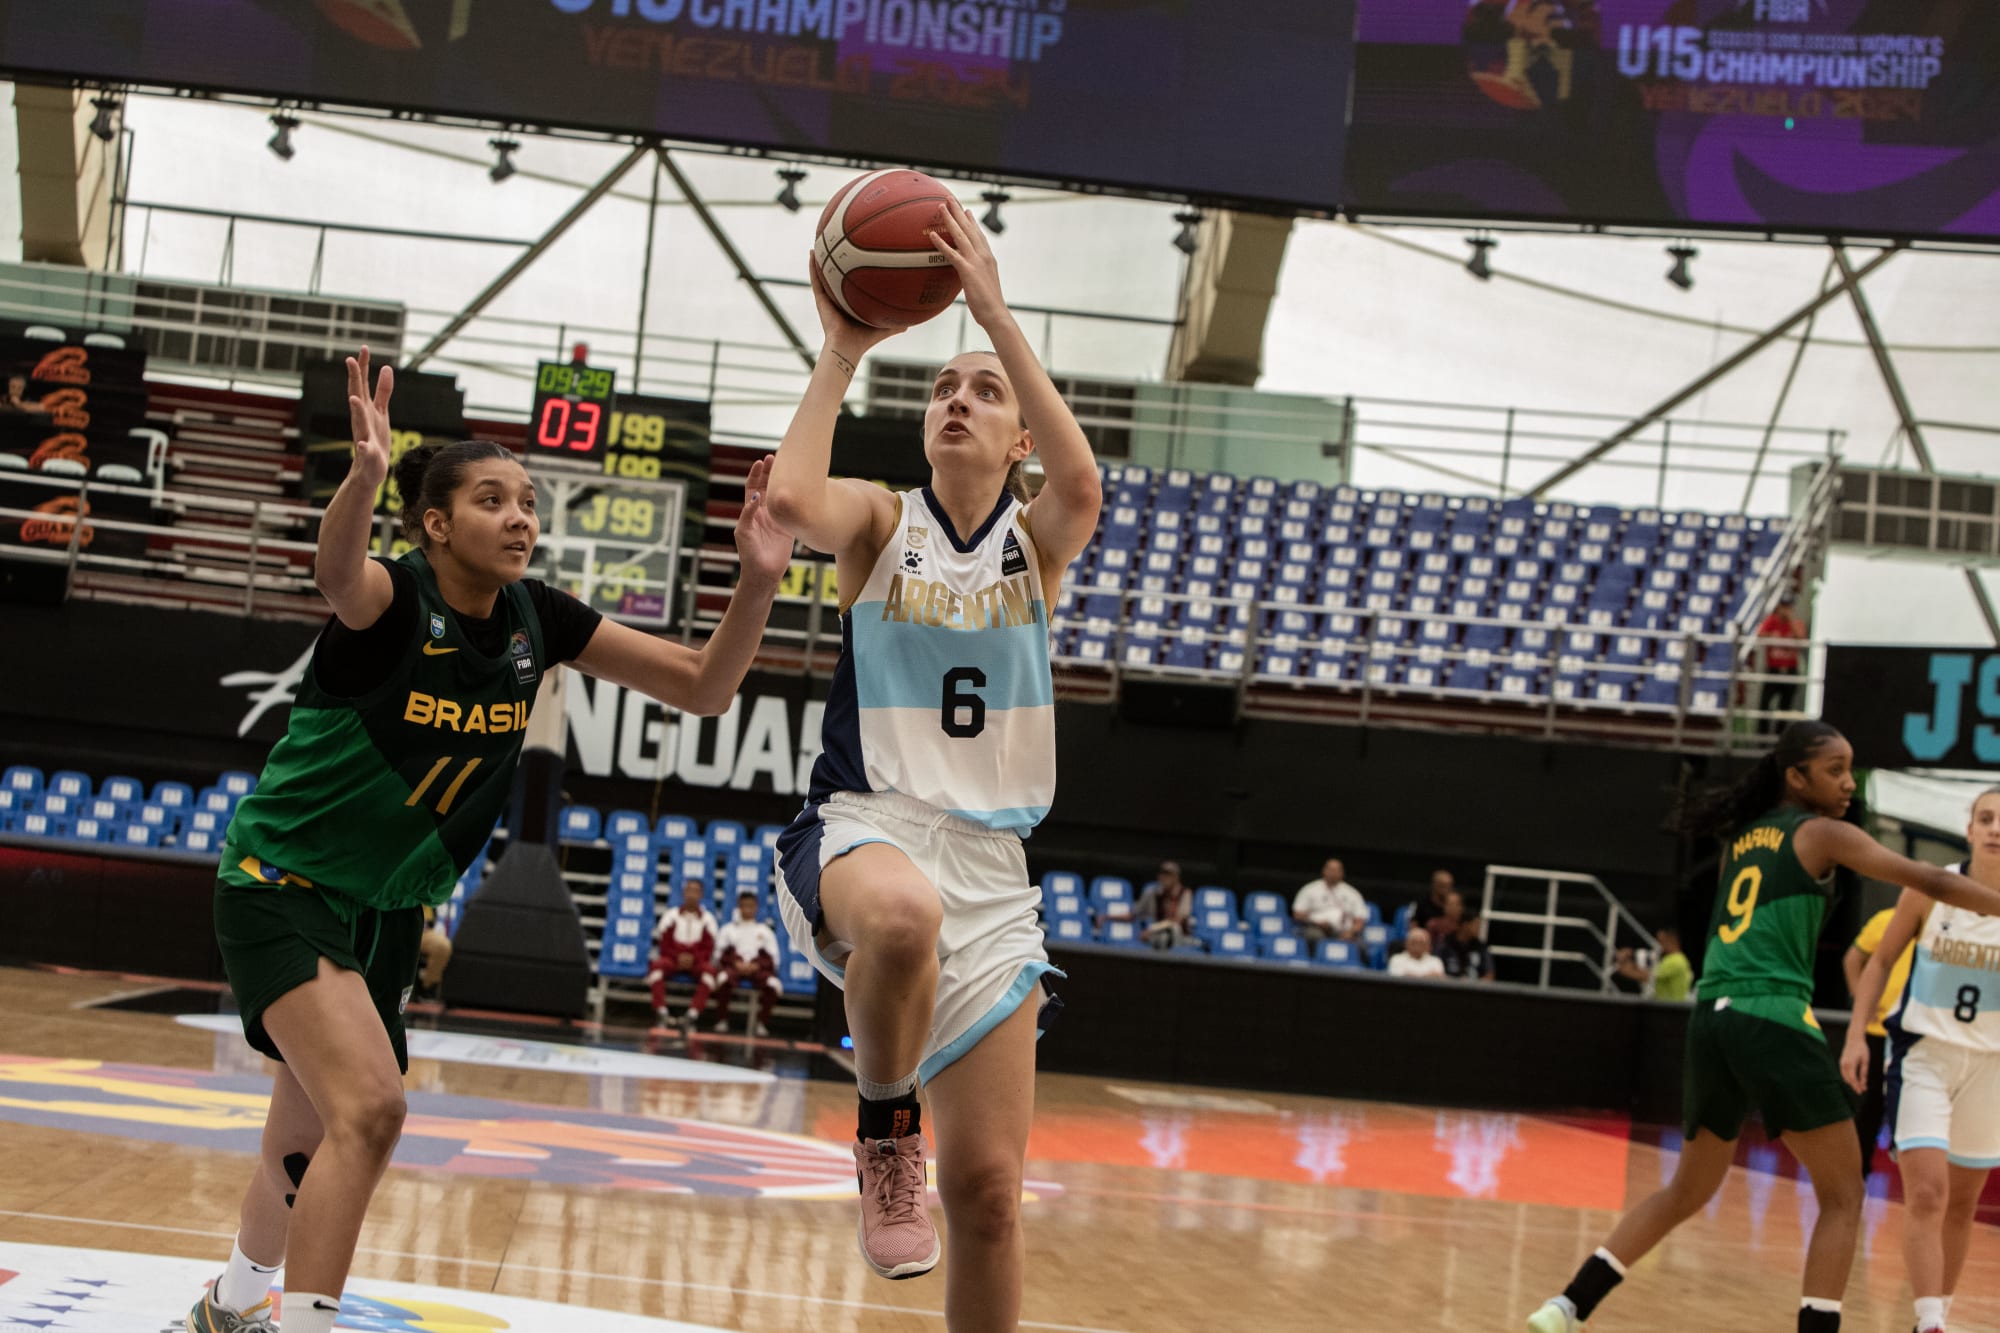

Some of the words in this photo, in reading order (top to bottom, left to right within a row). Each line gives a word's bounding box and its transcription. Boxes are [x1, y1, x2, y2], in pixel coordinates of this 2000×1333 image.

[1617, 24, 1703, 81] U15
[1703, 51, 1942, 89] CHAMPIONSHIP
[538, 364, 612, 399] 09:29
[537, 397, 601, 451] 03
[580, 494, 655, 537] J99
[899, 564, 922, 576] KELME
[1002, 549, 1020, 563] FIBA
[516, 657, 532, 670] FIBA
[404, 690, 529, 735] BRASIL
[941, 667, 986, 738] 6
[404, 756, 483, 816] 11
[1718, 865, 1763, 944] 9
[1953, 983, 1981, 1024] 8
